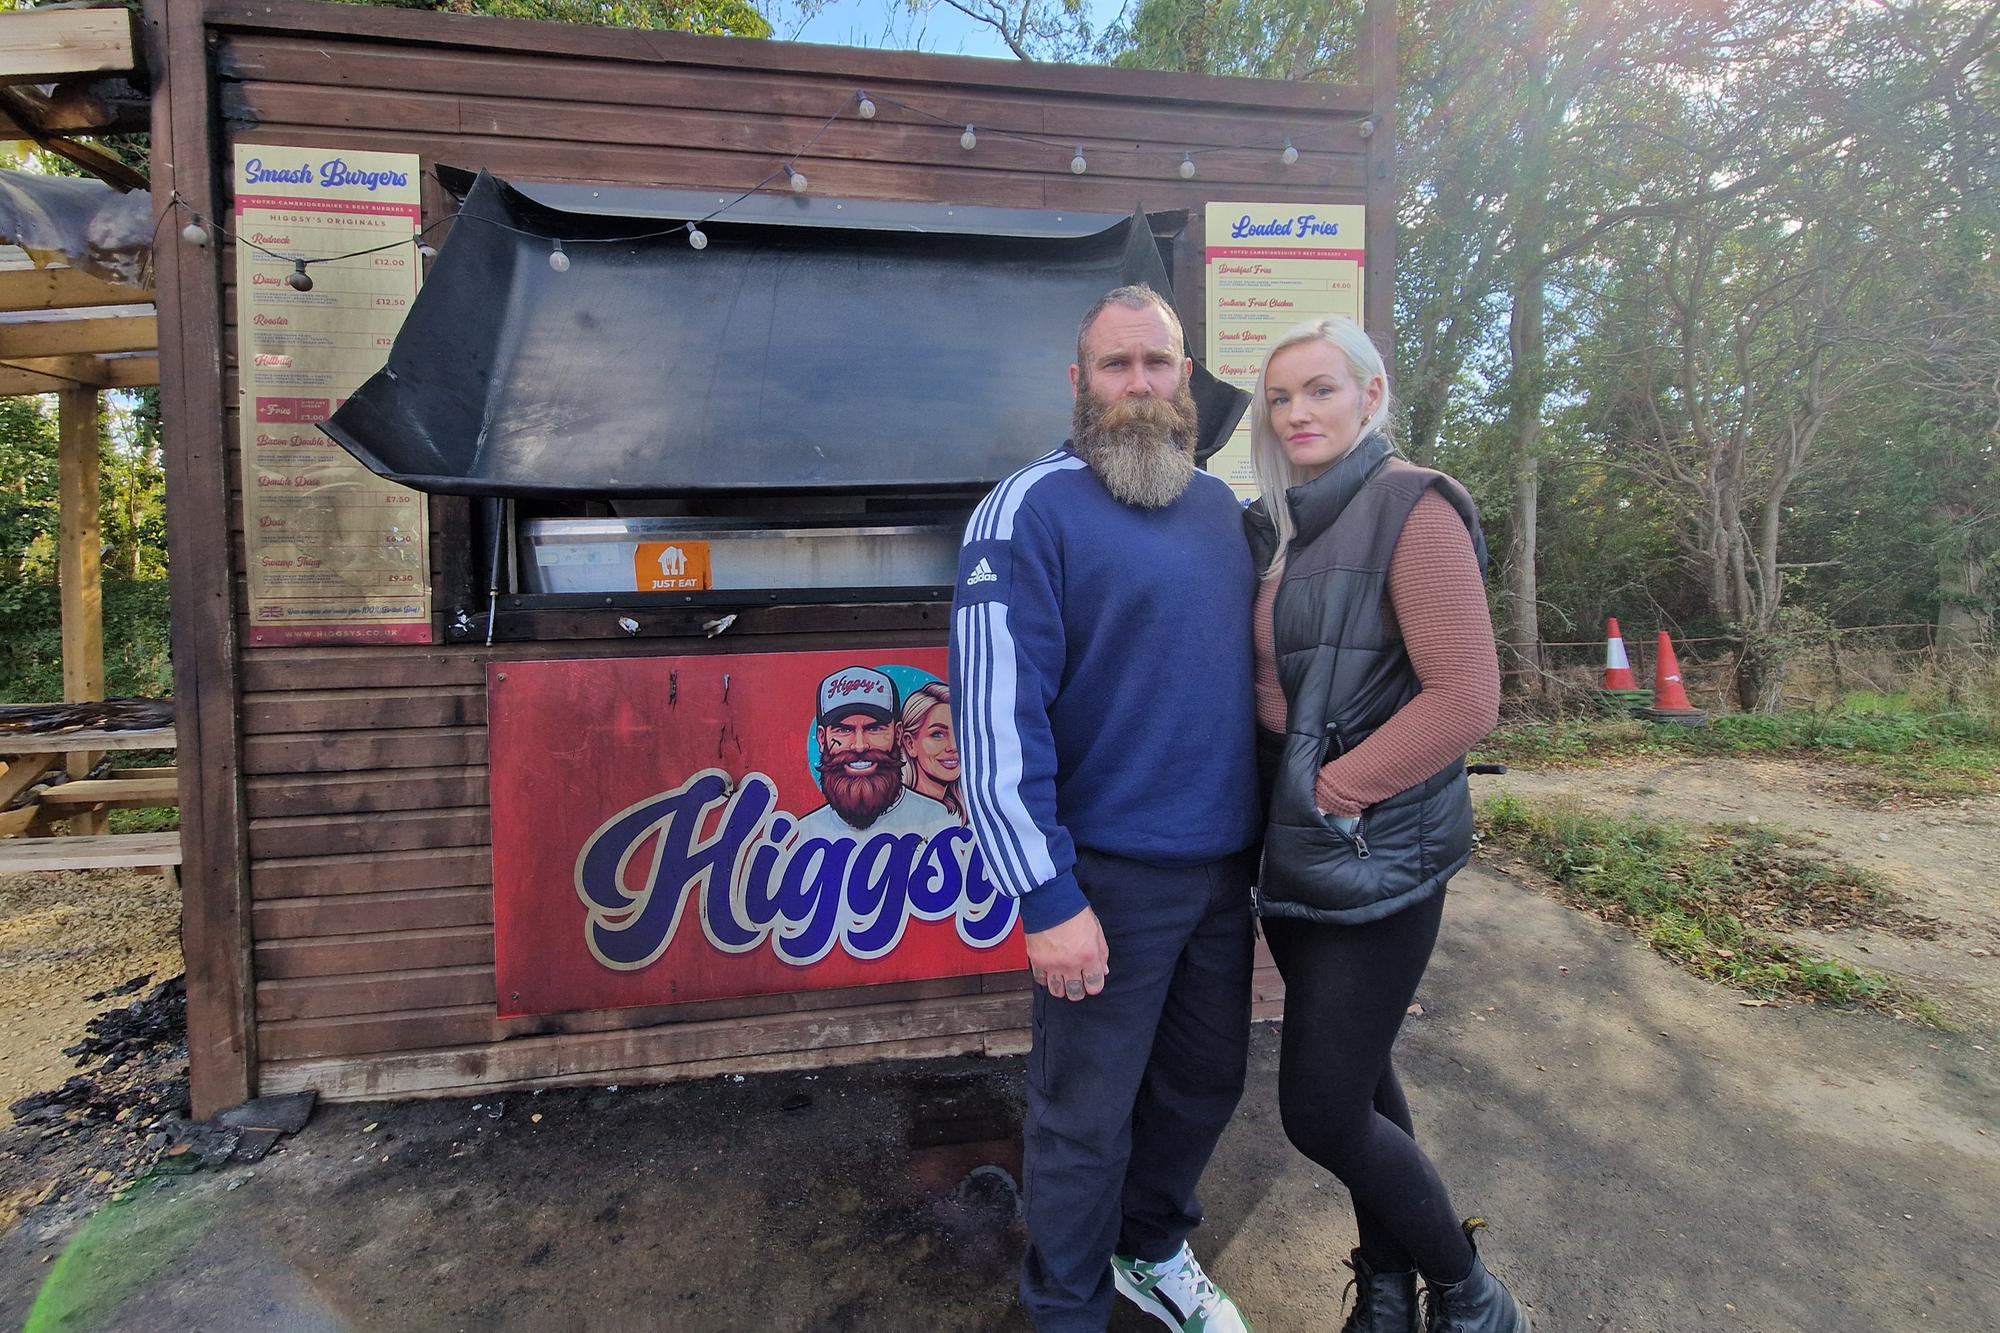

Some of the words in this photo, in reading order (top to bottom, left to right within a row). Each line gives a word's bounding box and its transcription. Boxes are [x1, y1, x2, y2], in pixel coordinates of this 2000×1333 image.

[245, 158, 313, 185] Smash
[319, 157, 408, 191] Burgers
[270, 215, 322, 224] HIGGSY'S
[327, 217, 387, 227] ORIGINALS
[1231, 215, 1294, 239] Loaded
[1296, 214, 1339, 239] Fries
[251, 232, 290, 245] Redneck
[374, 258, 405, 267] £12.00
[252, 273, 281, 287] Daisy
[375, 298, 406, 307] £12.50
[253, 313, 289, 326] Rooster
[376, 338, 392, 347] £12
[257, 434, 288, 447] Bacon
[290, 435, 325, 447] Double
[262, 556, 293, 568] Swamp
[296, 554, 322, 568] Thing
[651, 579, 677, 590] JUST
[678, 578, 698, 588] EAT
[967, 572, 998, 586] adidas
[827, 675, 884, 699] Higgsy's
